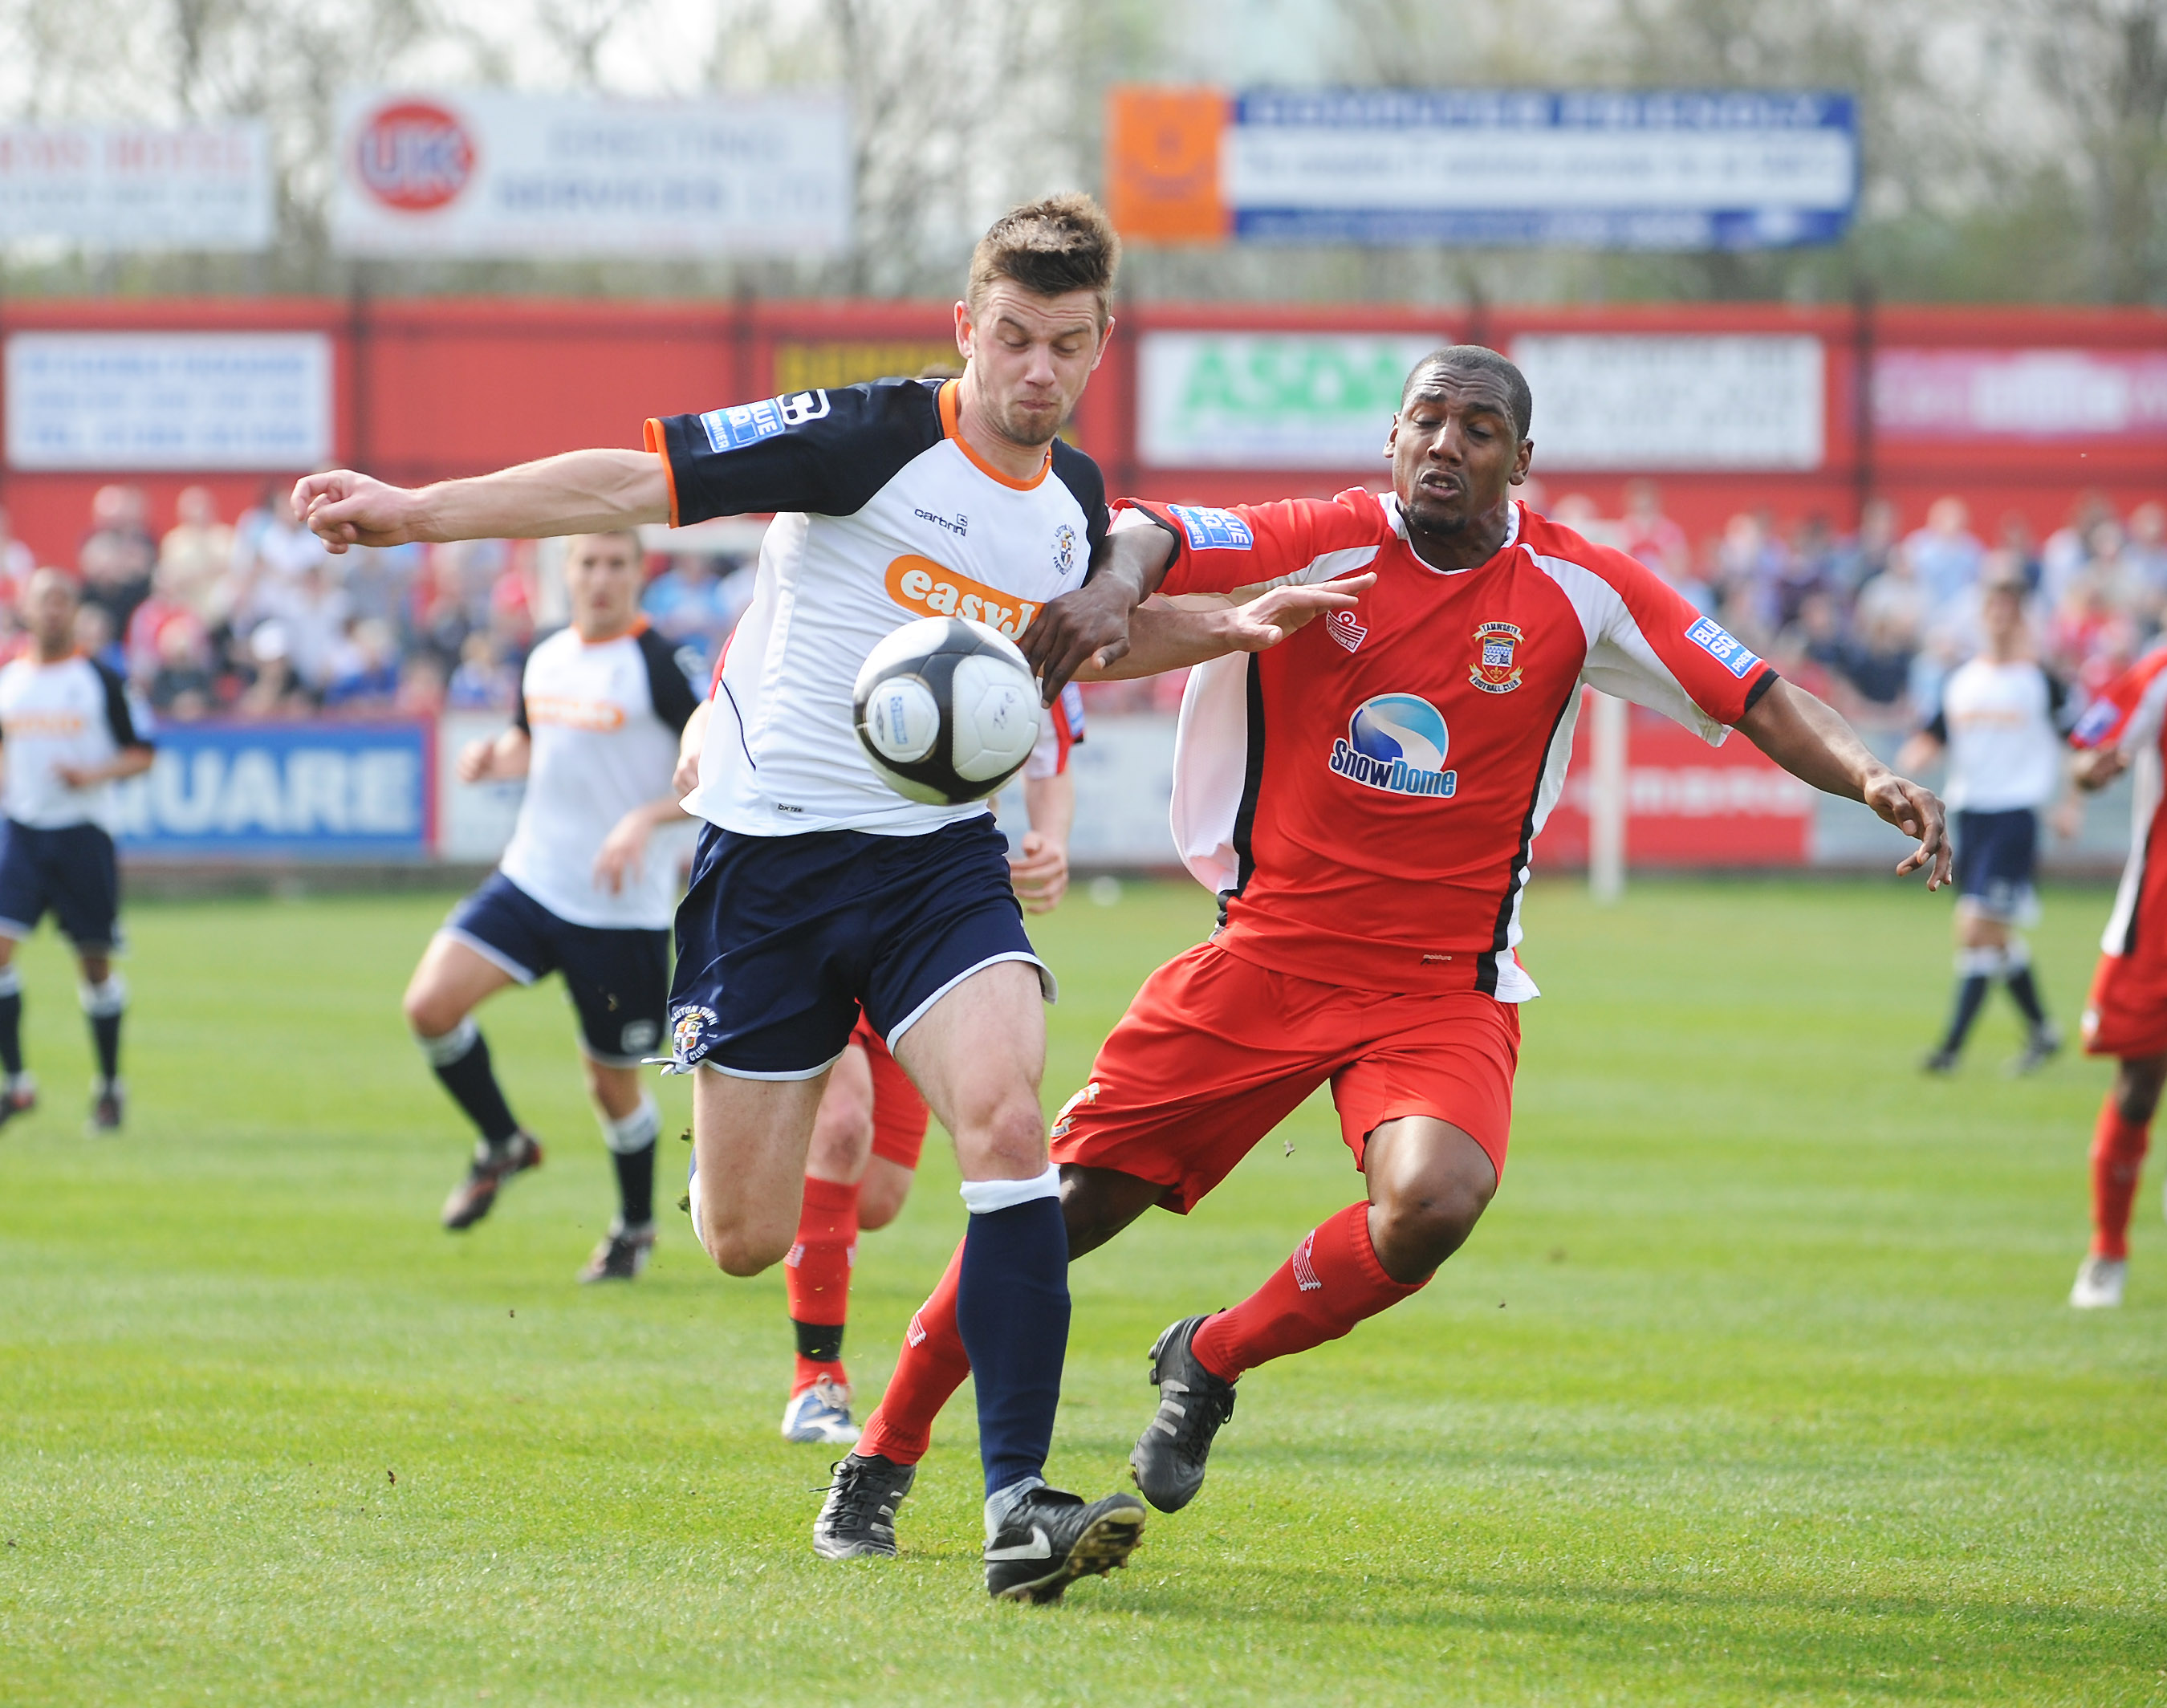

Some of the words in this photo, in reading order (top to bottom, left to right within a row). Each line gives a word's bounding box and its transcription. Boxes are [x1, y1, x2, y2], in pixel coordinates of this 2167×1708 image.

[901, 569, 1036, 641] easyJ
[1482, 623, 1519, 635] TAMWORTH
[1331, 739, 1456, 796] SnowDome
[670, 1005, 699, 1023] LUTON
[698, 1007, 718, 1027] TOWN
[689, 1043, 709, 1062] CLUB
